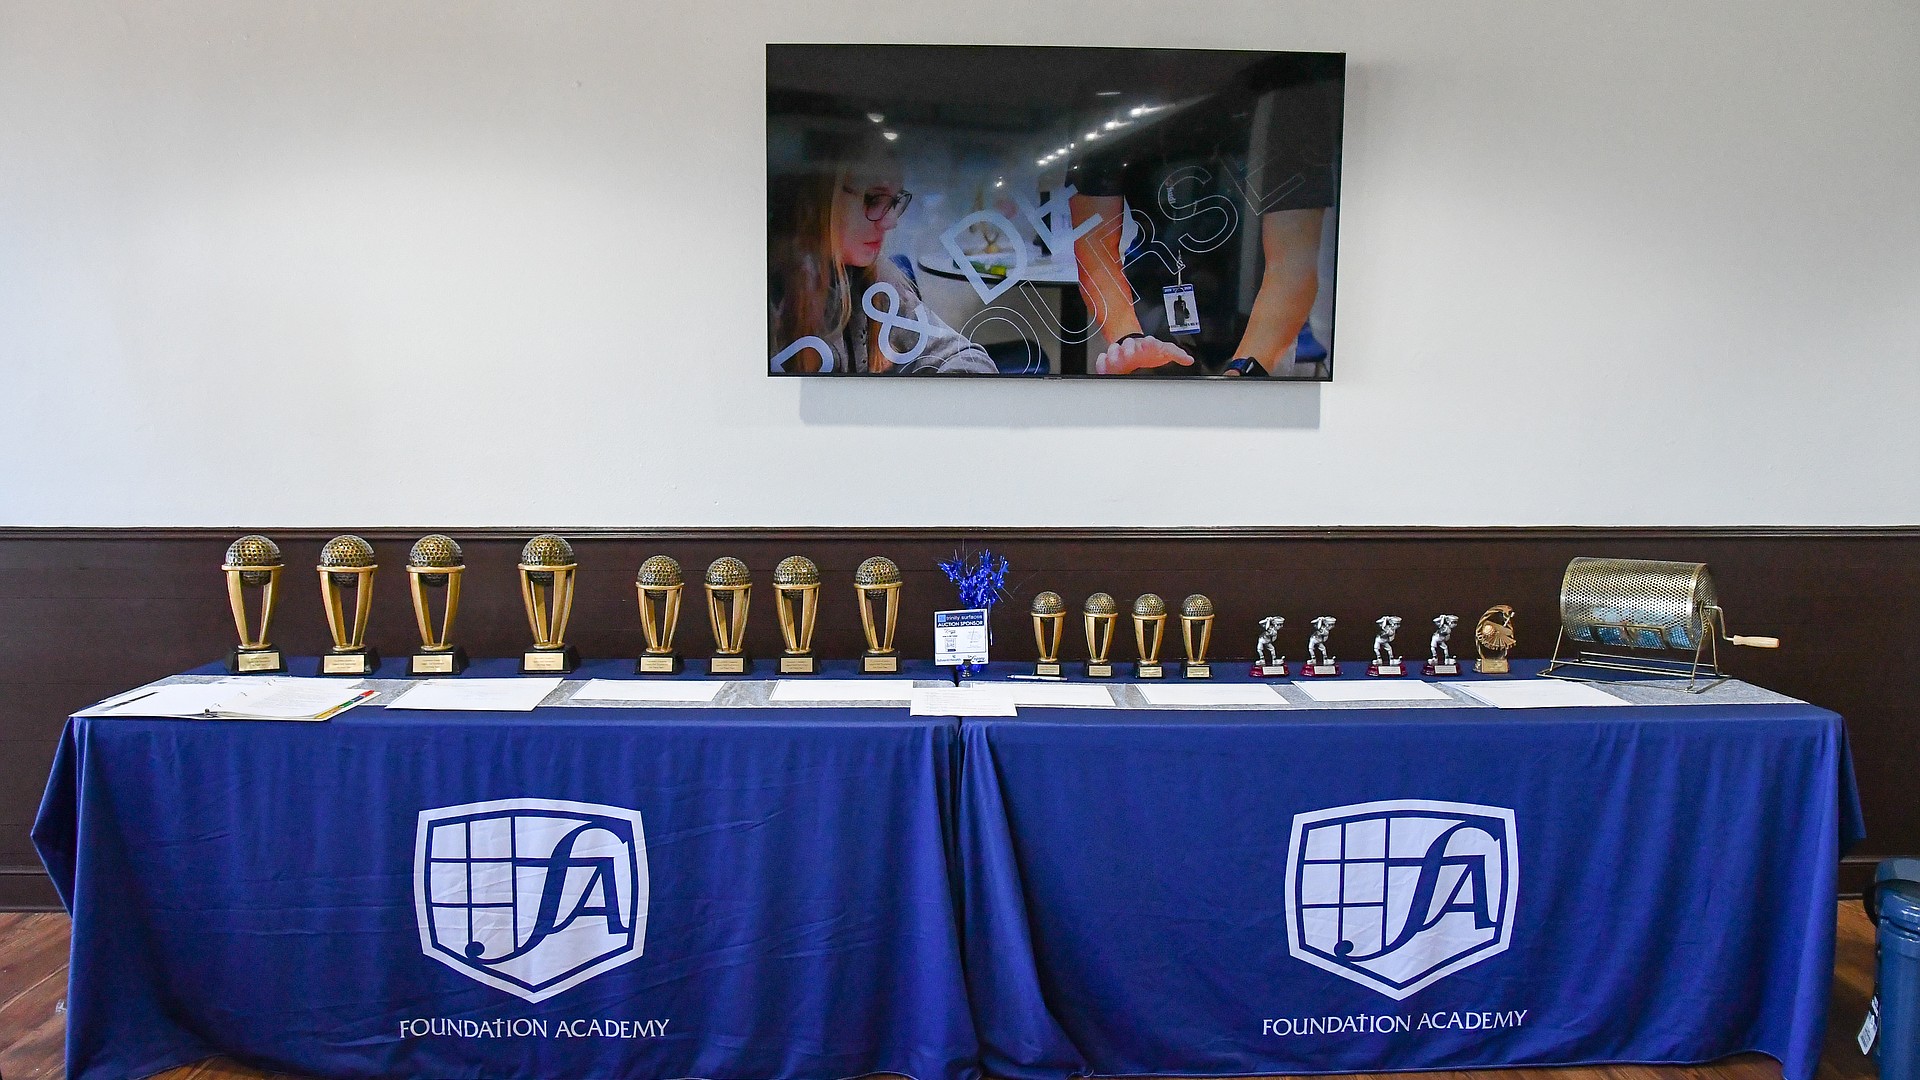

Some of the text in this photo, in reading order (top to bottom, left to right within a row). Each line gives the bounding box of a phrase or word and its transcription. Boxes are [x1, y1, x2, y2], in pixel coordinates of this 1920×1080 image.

[862, 281, 950, 364] &
[399, 1018, 670, 1039] FOUNDATION ACADEMY
[1262, 1009, 1528, 1036] FOUNDATION ACADEMY
